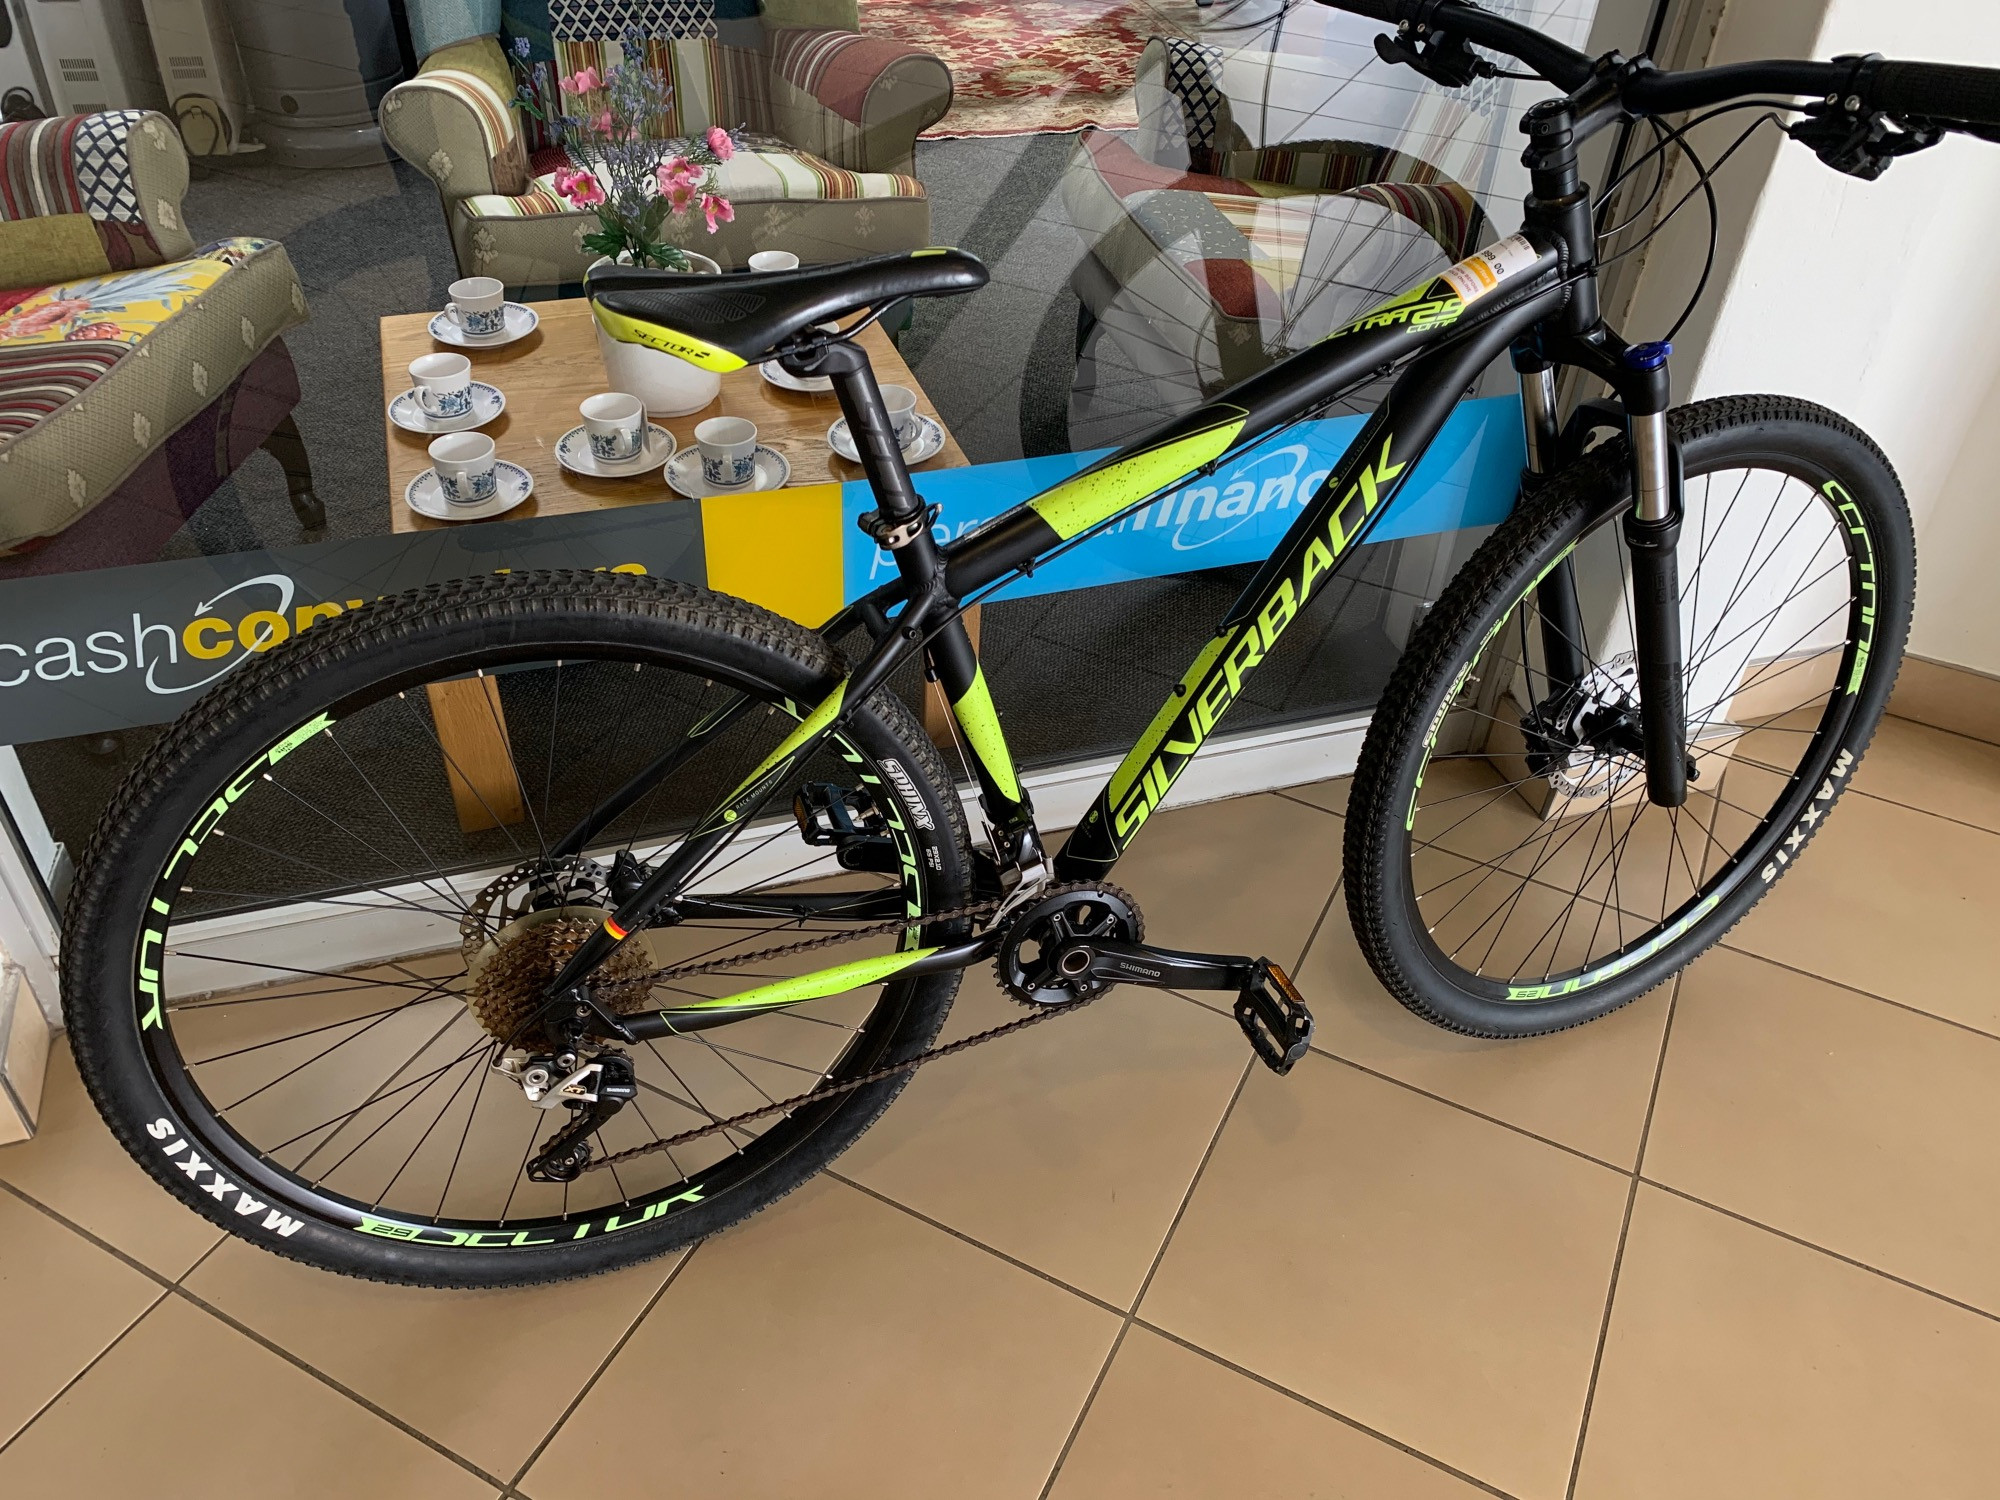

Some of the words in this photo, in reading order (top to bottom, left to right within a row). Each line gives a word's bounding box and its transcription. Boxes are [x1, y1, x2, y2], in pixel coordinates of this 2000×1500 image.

[1114, 433, 1407, 850] SILVERBACK
[877, 758, 935, 830] SPHINX
[1761, 748, 1854, 884] MAXXIS
[1119, 962, 1161, 978] SHIMANO
[146, 1117, 305, 1238] MAXXIS
